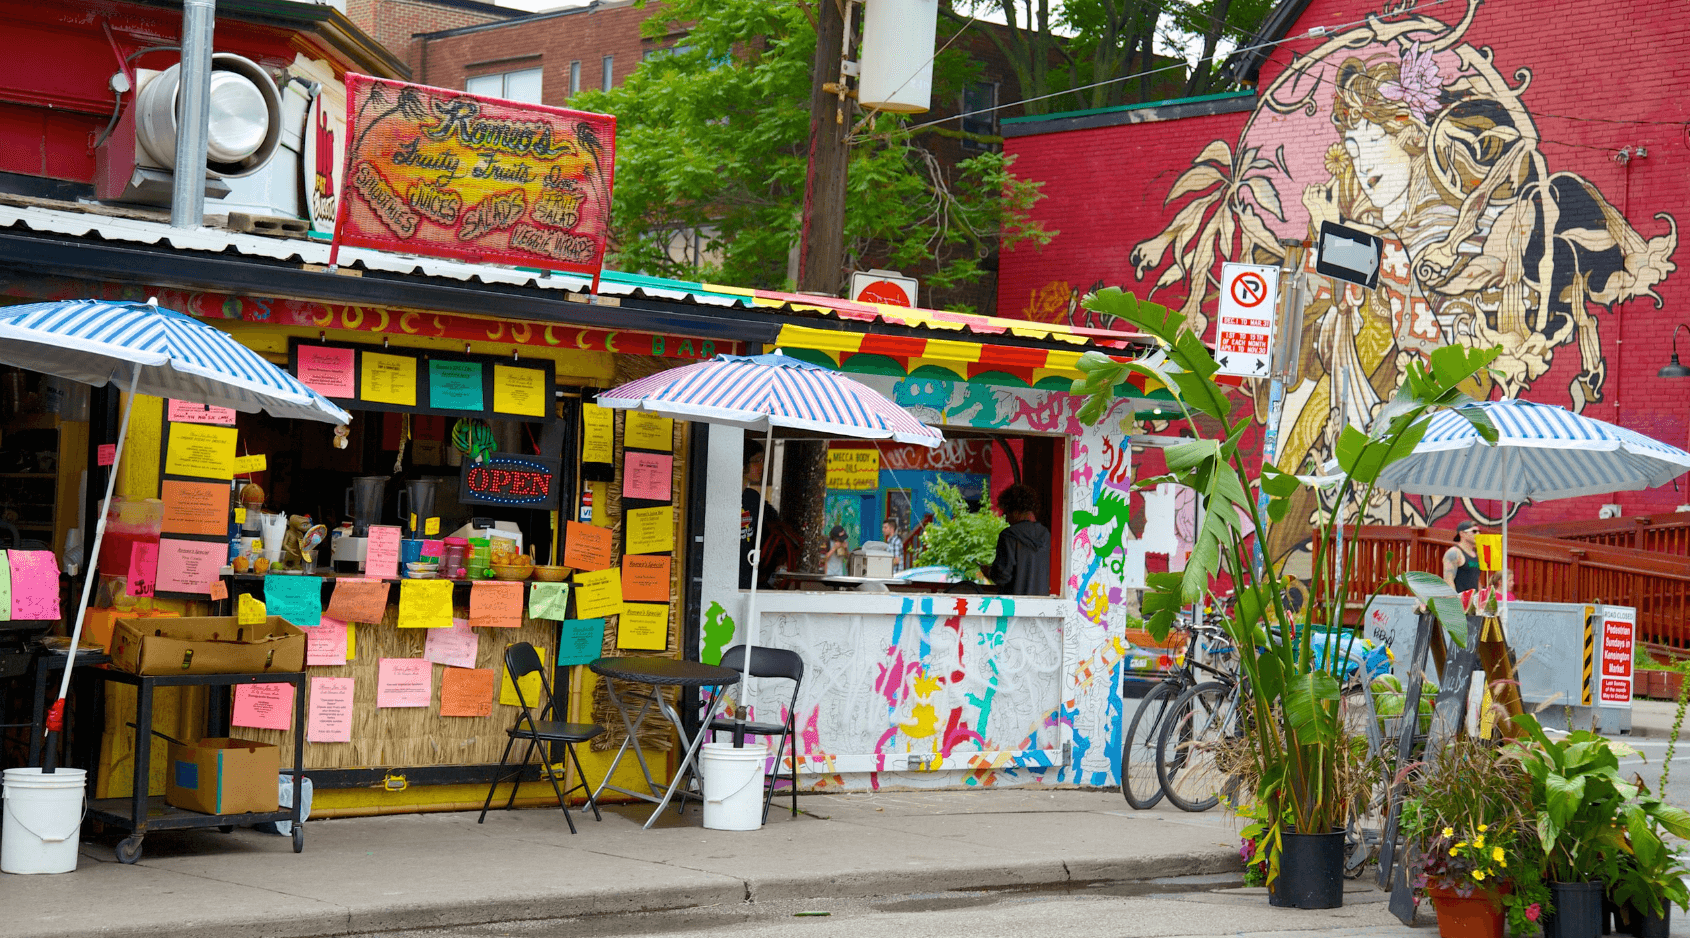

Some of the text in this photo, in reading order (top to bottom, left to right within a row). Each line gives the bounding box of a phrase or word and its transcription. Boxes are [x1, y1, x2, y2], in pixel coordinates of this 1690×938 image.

[424, 99, 573, 157] Romeo's
[393, 137, 467, 187] Fruity
[471, 152, 537, 183] Fruits
[356, 166, 415, 233] SMOOTHIES
[410, 183, 458, 221] JUICES
[464, 193, 524, 238] SALADS
[537, 205, 578, 229] SALAD
[553, 233, 596, 259] WRAPS
[651, 334, 717, 358] BAR
[832, 452, 871, 463] MECCA BODY
[467, 467, 553, 496] OPEN
[582, 508, 592, 517] VI
[1604, 611, 1633, 620] ROAD CLOSED
[1606, 624, 1631, 636] Pedestrian
[1606, 637, 1631, 650] Sundays in
[1604, 650, 1630, 663] Kensington
[1608, 663, 1625, 674] Market
